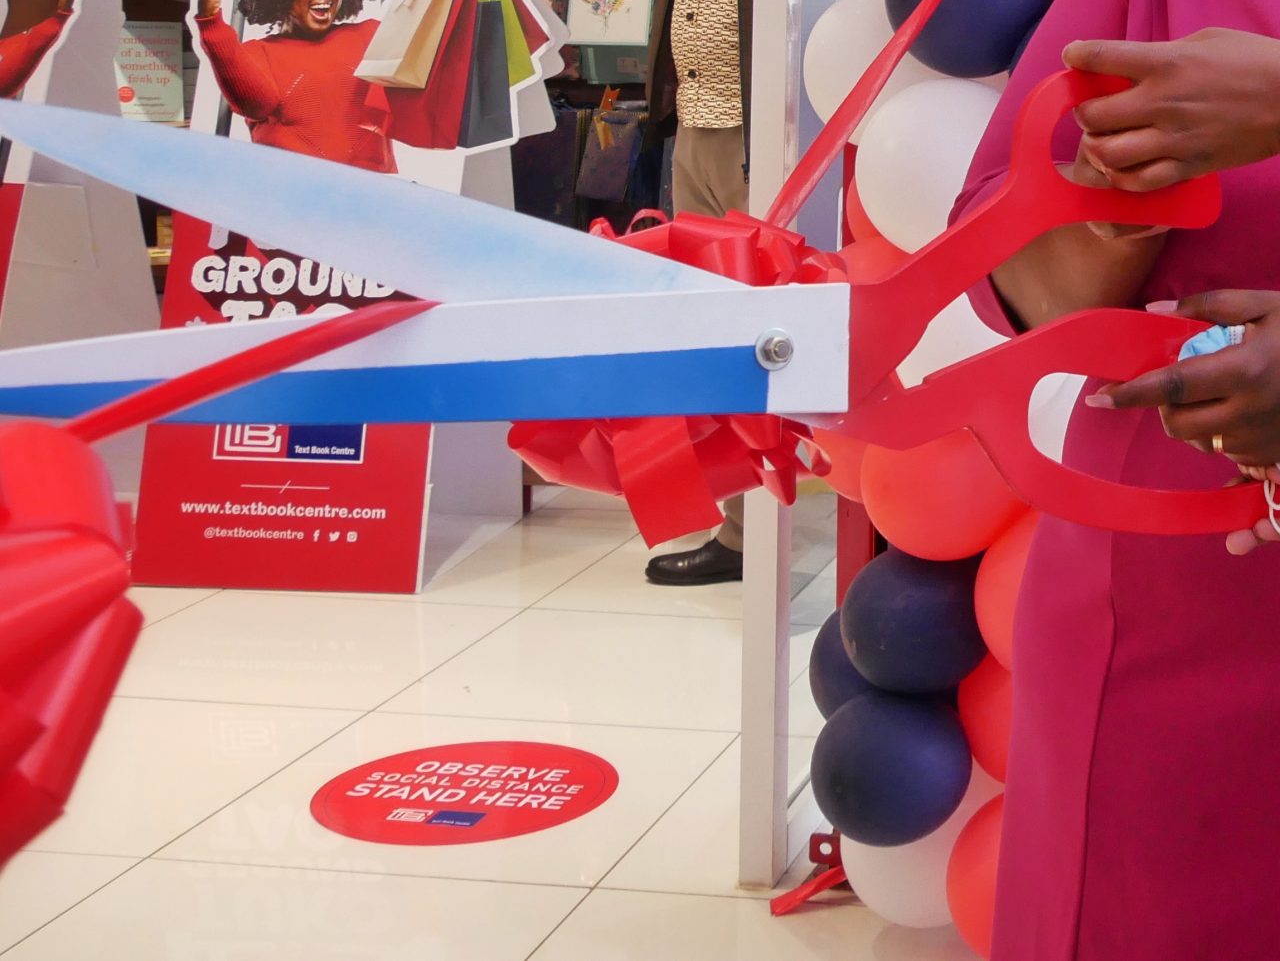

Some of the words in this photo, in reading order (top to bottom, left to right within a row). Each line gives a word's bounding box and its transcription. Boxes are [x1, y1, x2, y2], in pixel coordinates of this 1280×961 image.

[121, 61, 177, 72] something
[157, 78, 170, 86] up
[294, 445, 310, 454] Text
[311, 445, 330, 455] Book
[331, 447, 356, 456] Centre
[181, 500, 387, 519] www.textbookcentre.com
[204, 526, 304, 540] @textbookcentre
[416, 760, 570, 782] OBSERVE
[366, 772, 453, 787] SOCIAL
[462, 777, 584, 795] DISTANCE
[346, 783, 466, 804] STAND
[470, 791, 571, 810] HERE
